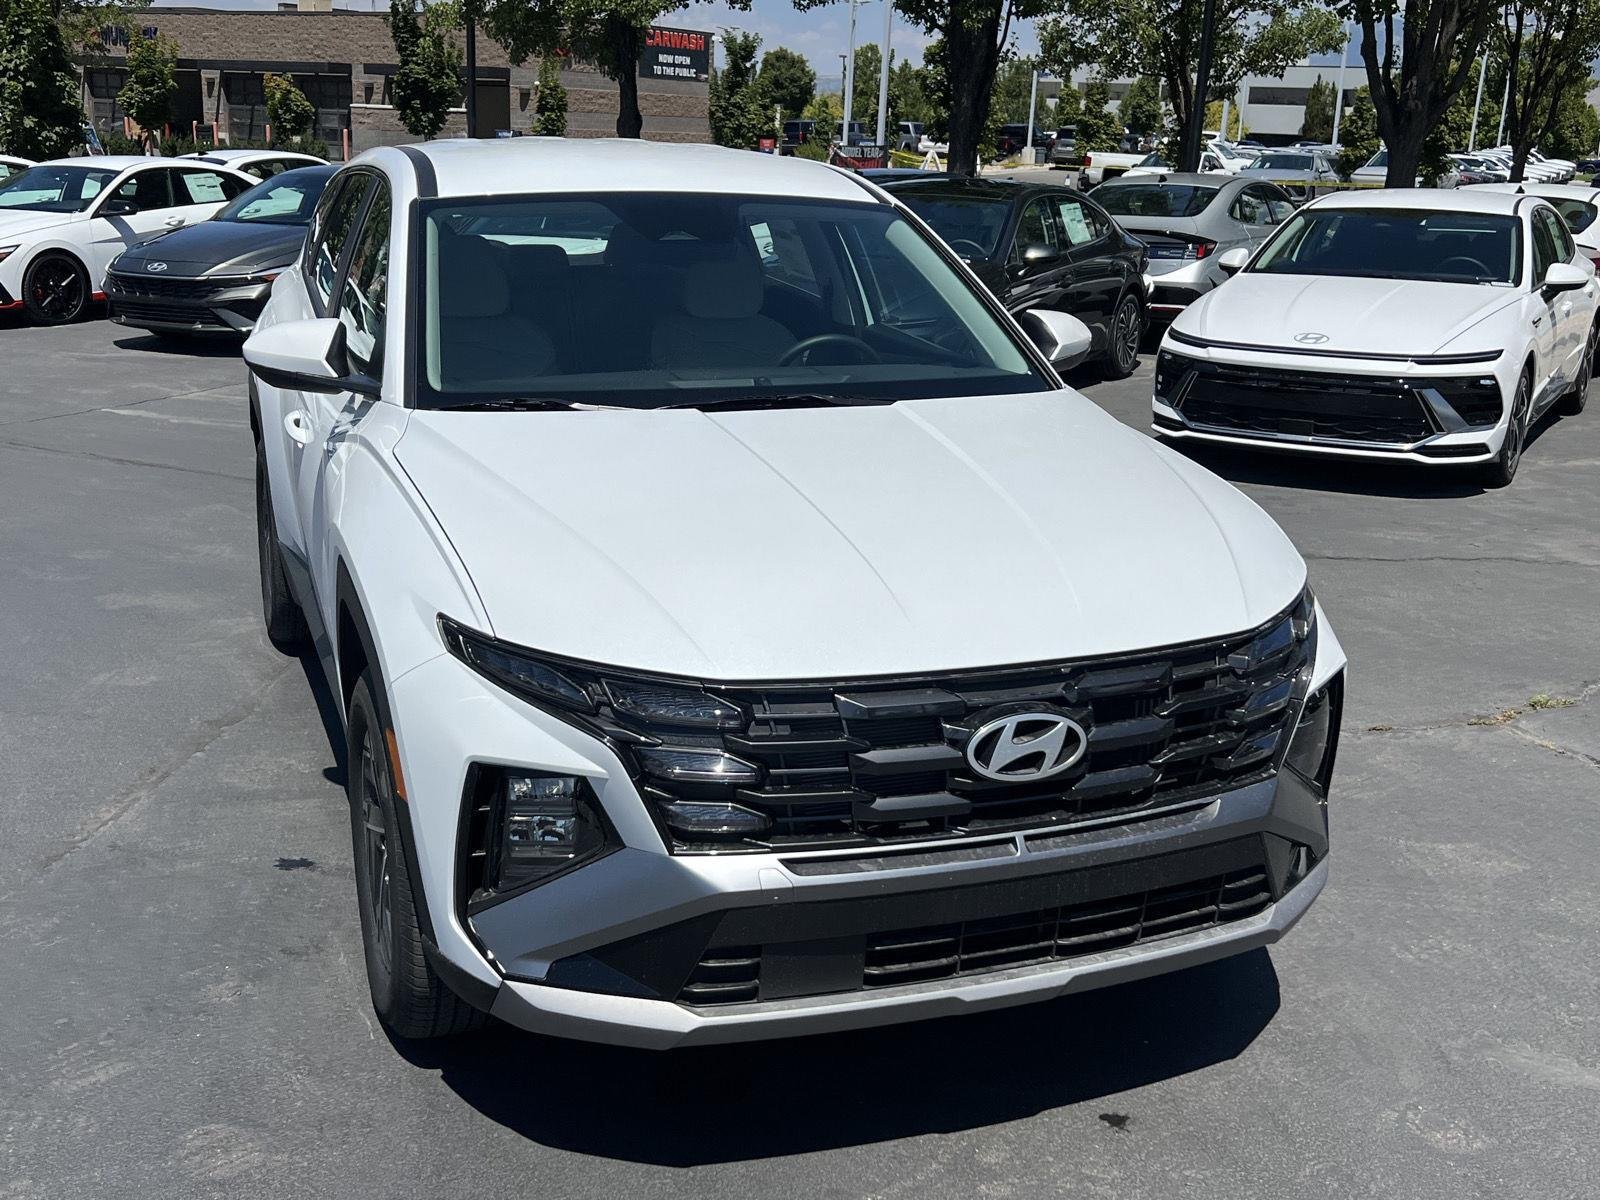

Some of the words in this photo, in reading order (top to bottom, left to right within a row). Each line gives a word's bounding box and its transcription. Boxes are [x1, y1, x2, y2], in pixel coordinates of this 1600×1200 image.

[646, 30, 704, 51] CARWASH
[658, 54, 674, 63] NOW
[675, 56, 691, 65] OPEN
[653, 66, 662, 75] TO
[663, 67, 674, 76] THE
[675, 68, 696, 77] PUBLIC
[863, 147, 879, 158] YEAR
